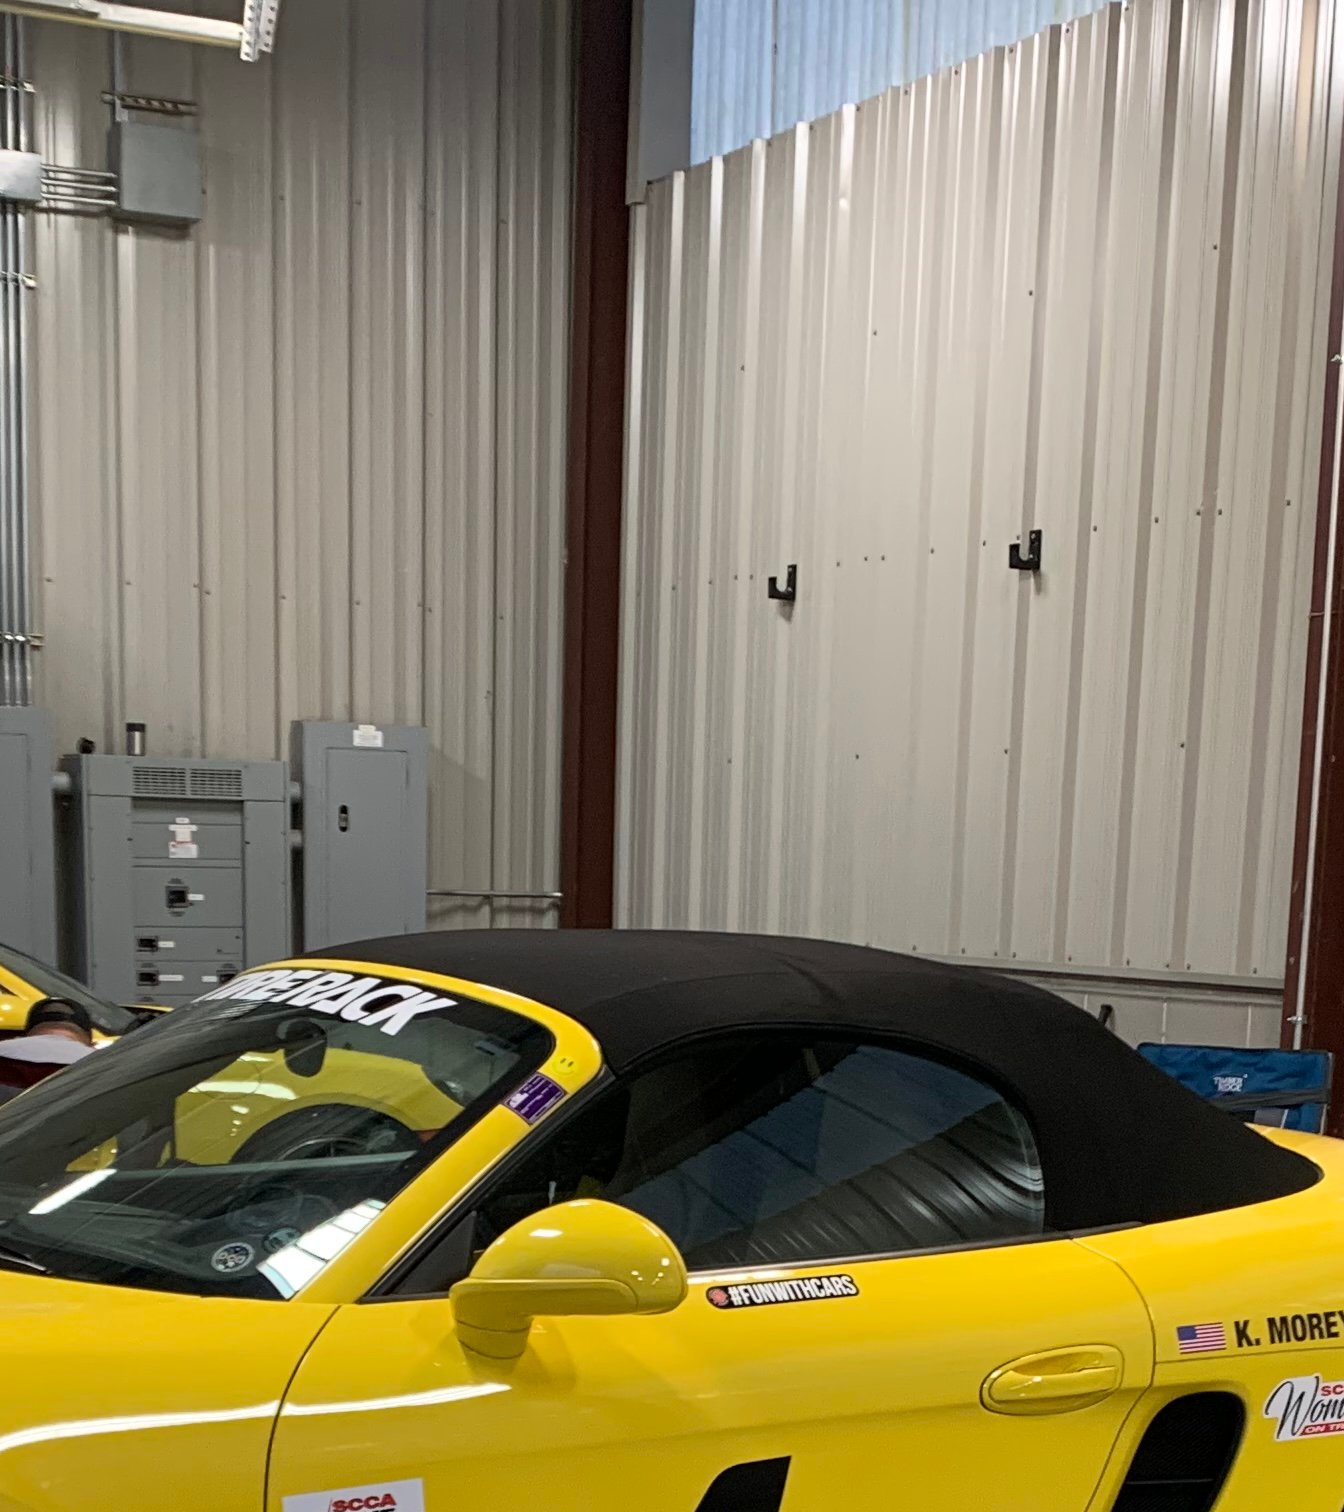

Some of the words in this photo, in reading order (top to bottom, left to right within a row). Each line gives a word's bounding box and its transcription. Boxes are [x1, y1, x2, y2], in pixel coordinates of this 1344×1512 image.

[727, 1276, 857, 1307] #FUNWITHCARS
[1234, 1320, 1261, 1348] K.
[1305, 1424, 1327, 1435] ON
